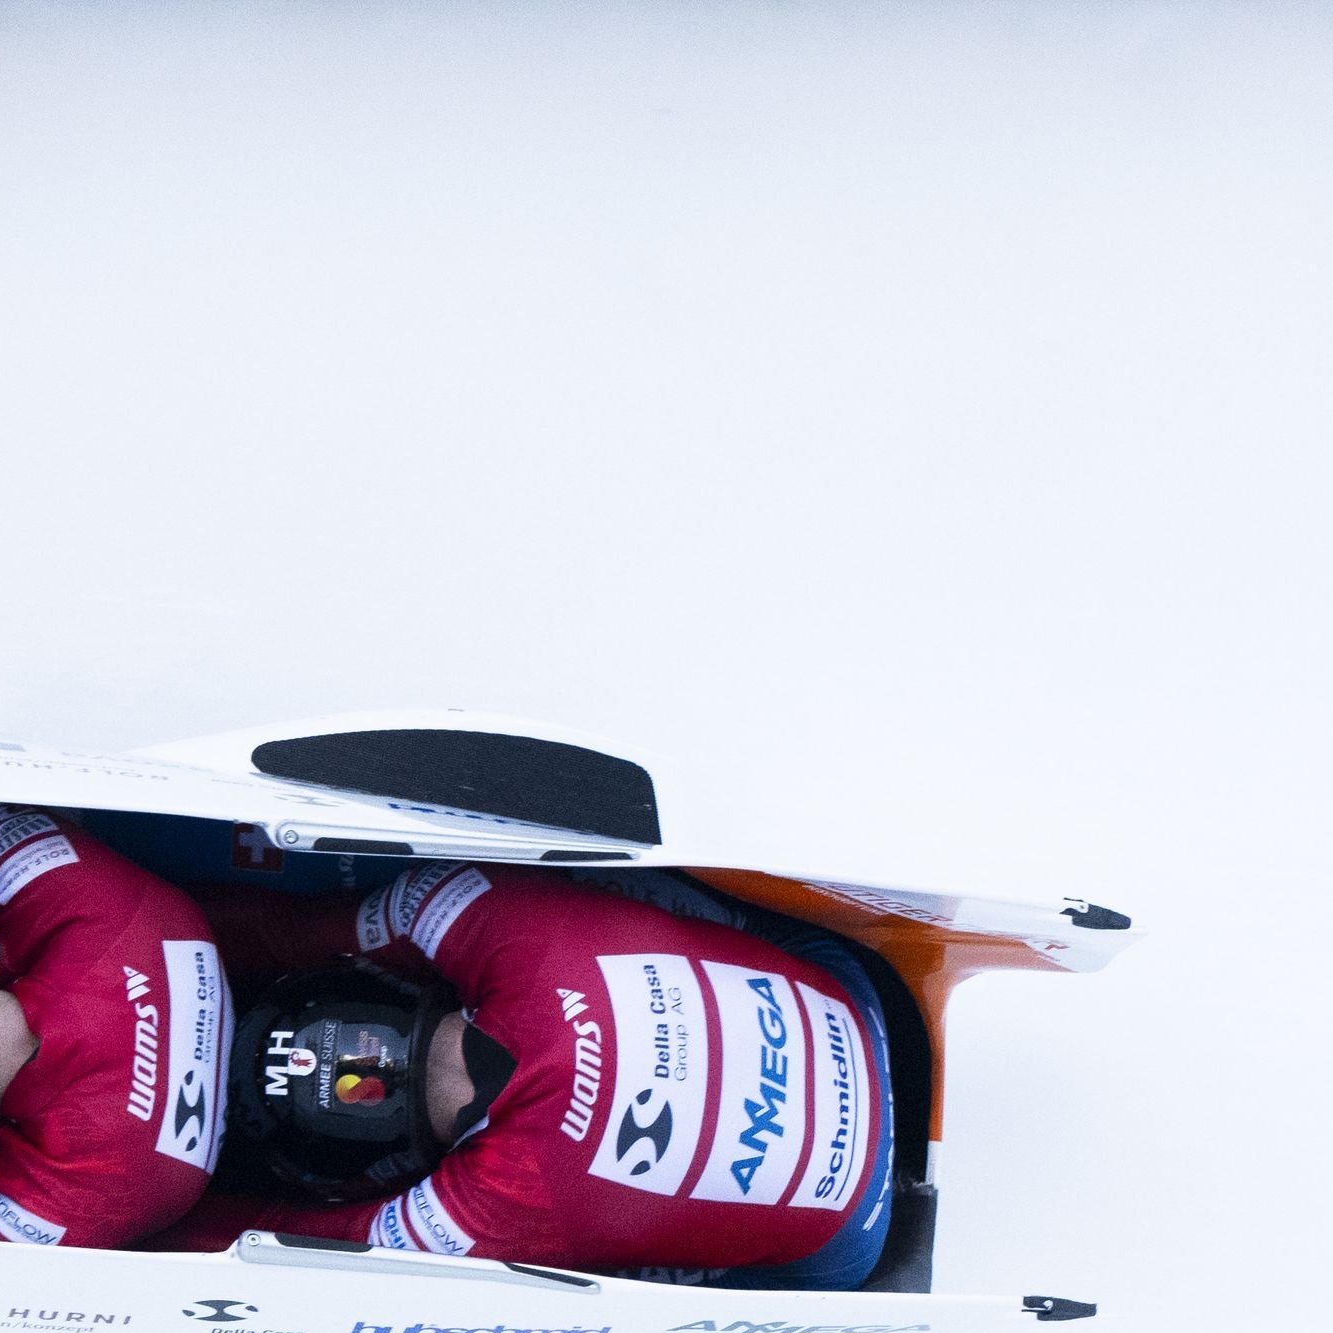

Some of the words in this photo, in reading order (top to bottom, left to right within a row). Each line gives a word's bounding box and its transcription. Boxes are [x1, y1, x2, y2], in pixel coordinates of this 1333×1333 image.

[194, 951, 208, 1001] Casa
[643, 964, 667, 1015] Casa
[668, 987, 682, 1017] AG
[194, 1009, 207, 1062] Della
[321, 1021, 337, 1061] SUISSE
[652, 1021, 673, 1079] Della
[673, 1024, 690, 1082] Group
[319, 1063, 332, 1109] ARMEE
[729, 976, 789, 1195] AMMEGA
[814, 1009, 851, 1200] Schmidlin
